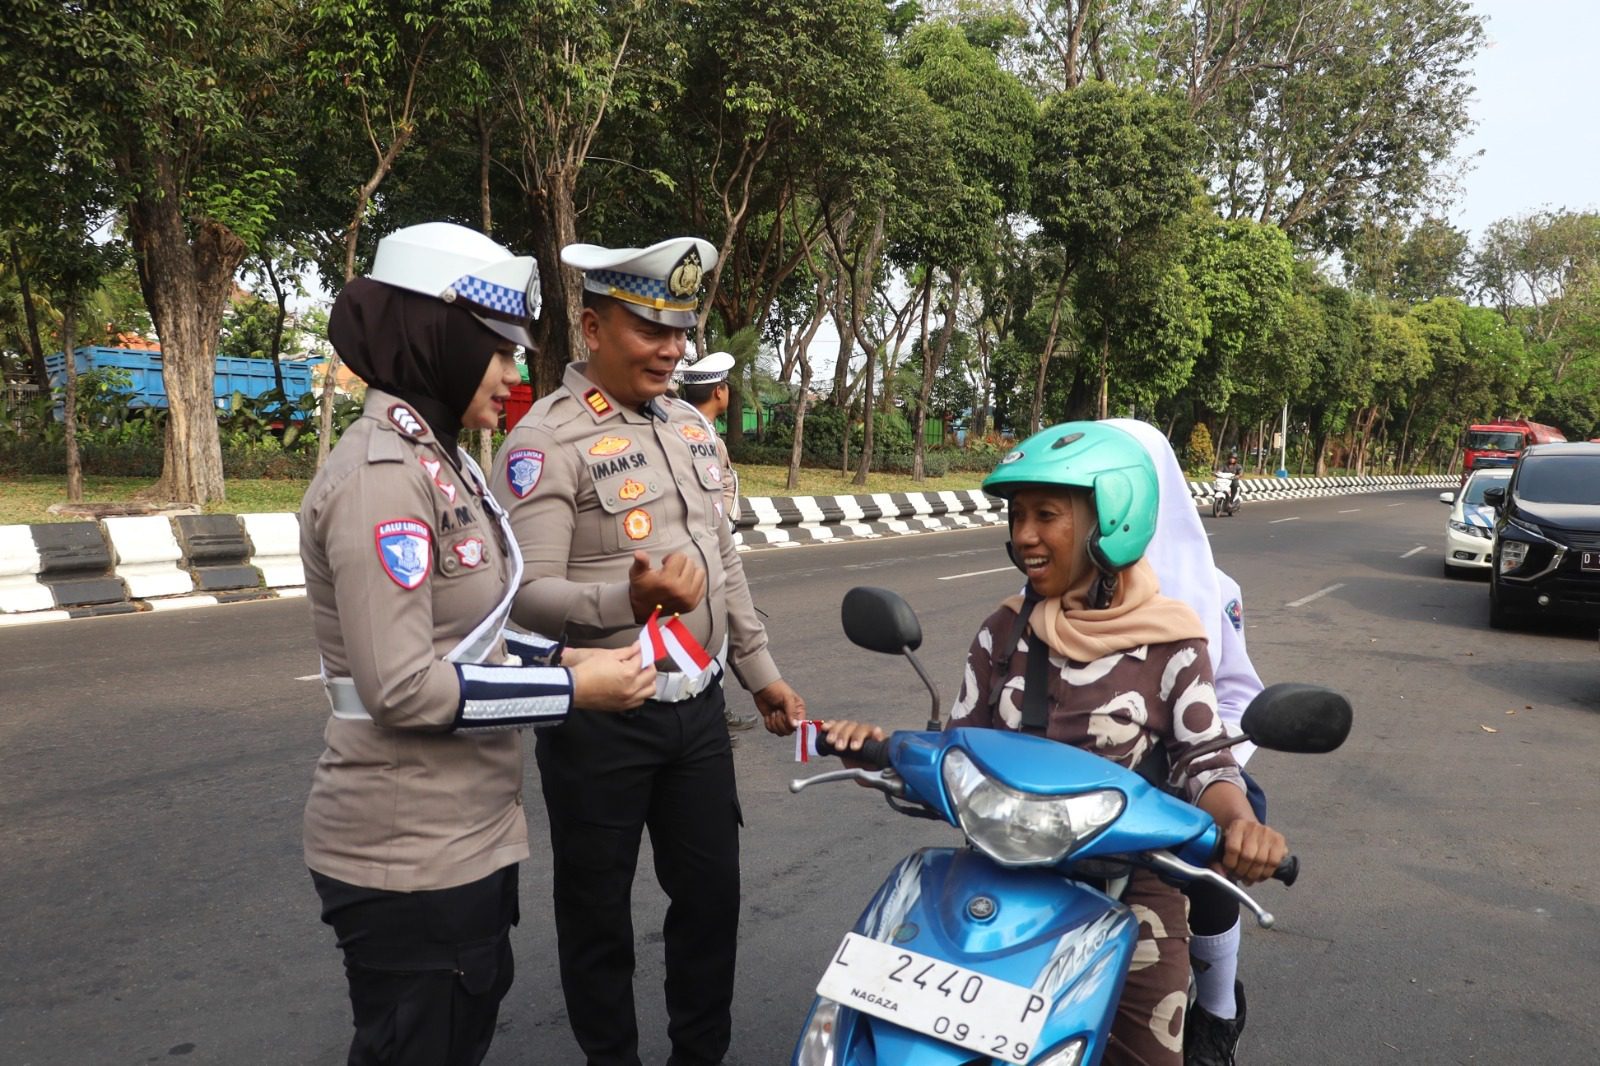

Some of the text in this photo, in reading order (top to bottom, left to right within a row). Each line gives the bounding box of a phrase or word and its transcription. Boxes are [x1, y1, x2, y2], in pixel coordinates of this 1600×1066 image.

[690, 443, 718, 458] POLR
[592, 452, 648, 480] IMAM SR
[380, 522, 402, 534] LALU
[1584, 553, 1591, 564] D
[835, 939, 1045, 1023] L 2440 P
[850, 987, 899, 1012] NAGAZA
